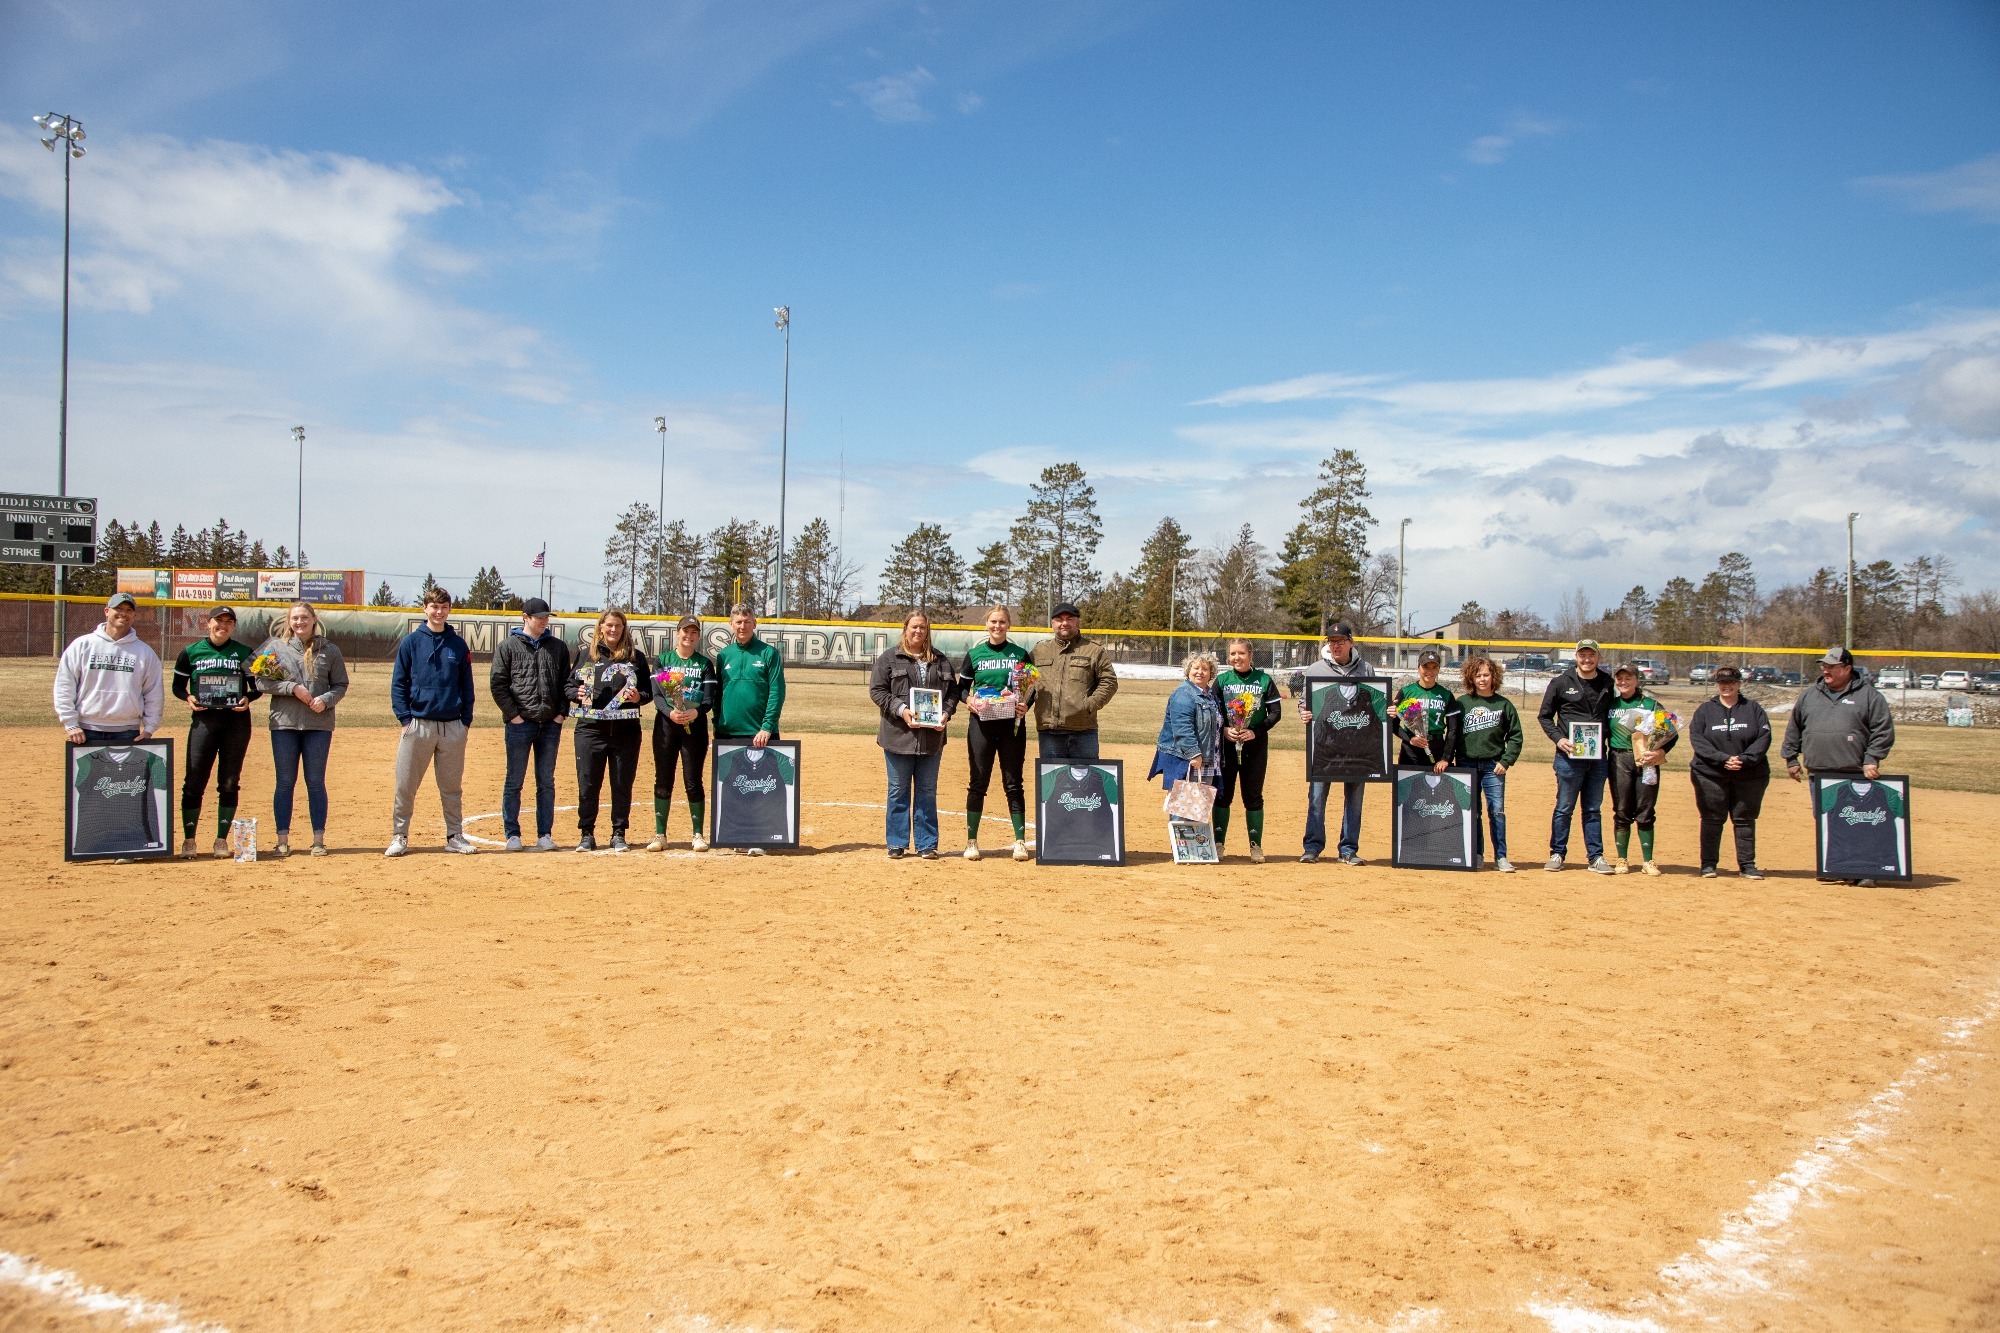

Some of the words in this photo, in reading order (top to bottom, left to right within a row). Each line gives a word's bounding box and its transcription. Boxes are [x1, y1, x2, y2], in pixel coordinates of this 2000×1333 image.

[0, 497, 29, 507] IDJI
[33, 500, 71, 510] STATE
[6, 513, 47, 524] INNING
[60, 516, 91, 526] HOME
[47, 527, 55, 536] E
[2, 547, 41, 557] STRIKE
[60, 550, 81, 559] OUT
[707, 627, 888, 665] SFTBALL
[90, 655, 136, 667] BEAVERS
[685, 667, 702, 678] STATE
[1245, 684, 1263, 694] STATE
[226, 697, 239, 705] 11
[1435, 712, 1441, 725] 7
